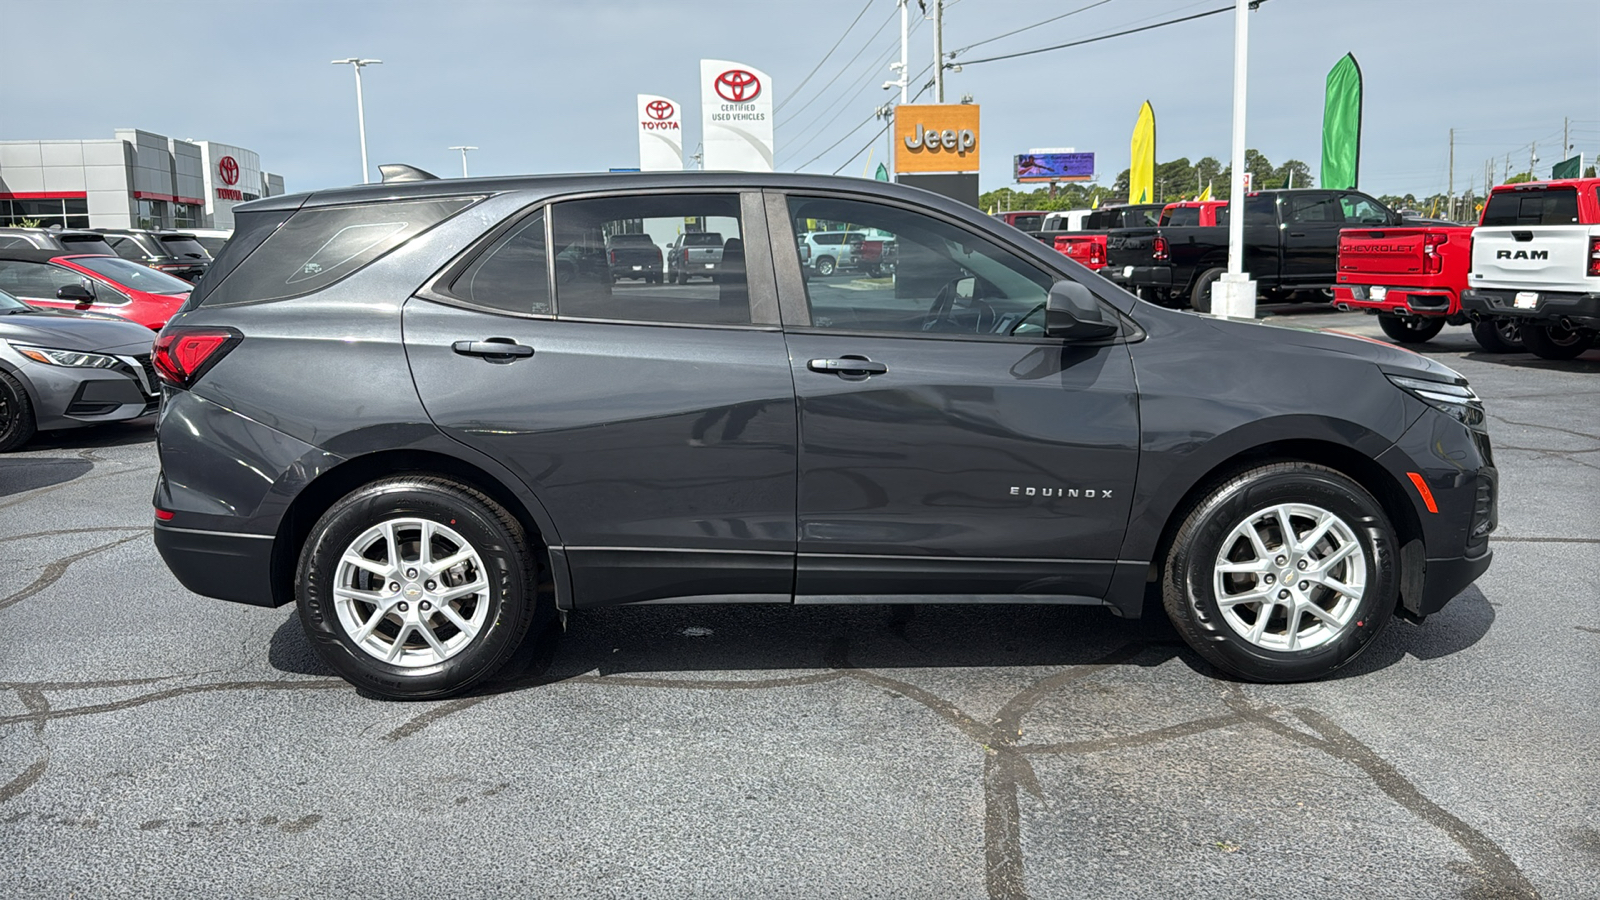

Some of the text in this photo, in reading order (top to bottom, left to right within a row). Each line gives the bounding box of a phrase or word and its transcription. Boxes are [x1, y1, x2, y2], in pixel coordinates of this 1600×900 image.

[712, 113, 765, 121] USED VEHICLES
[641, 121, 679, 130] TOYOTA
[905, 124, 975, 152] Jeep
[217, 188, 243, 201] TOYOTA
[1496, 250, 1549, 260] RAM
[1009, 486, 1113, 499] EQUINOX
